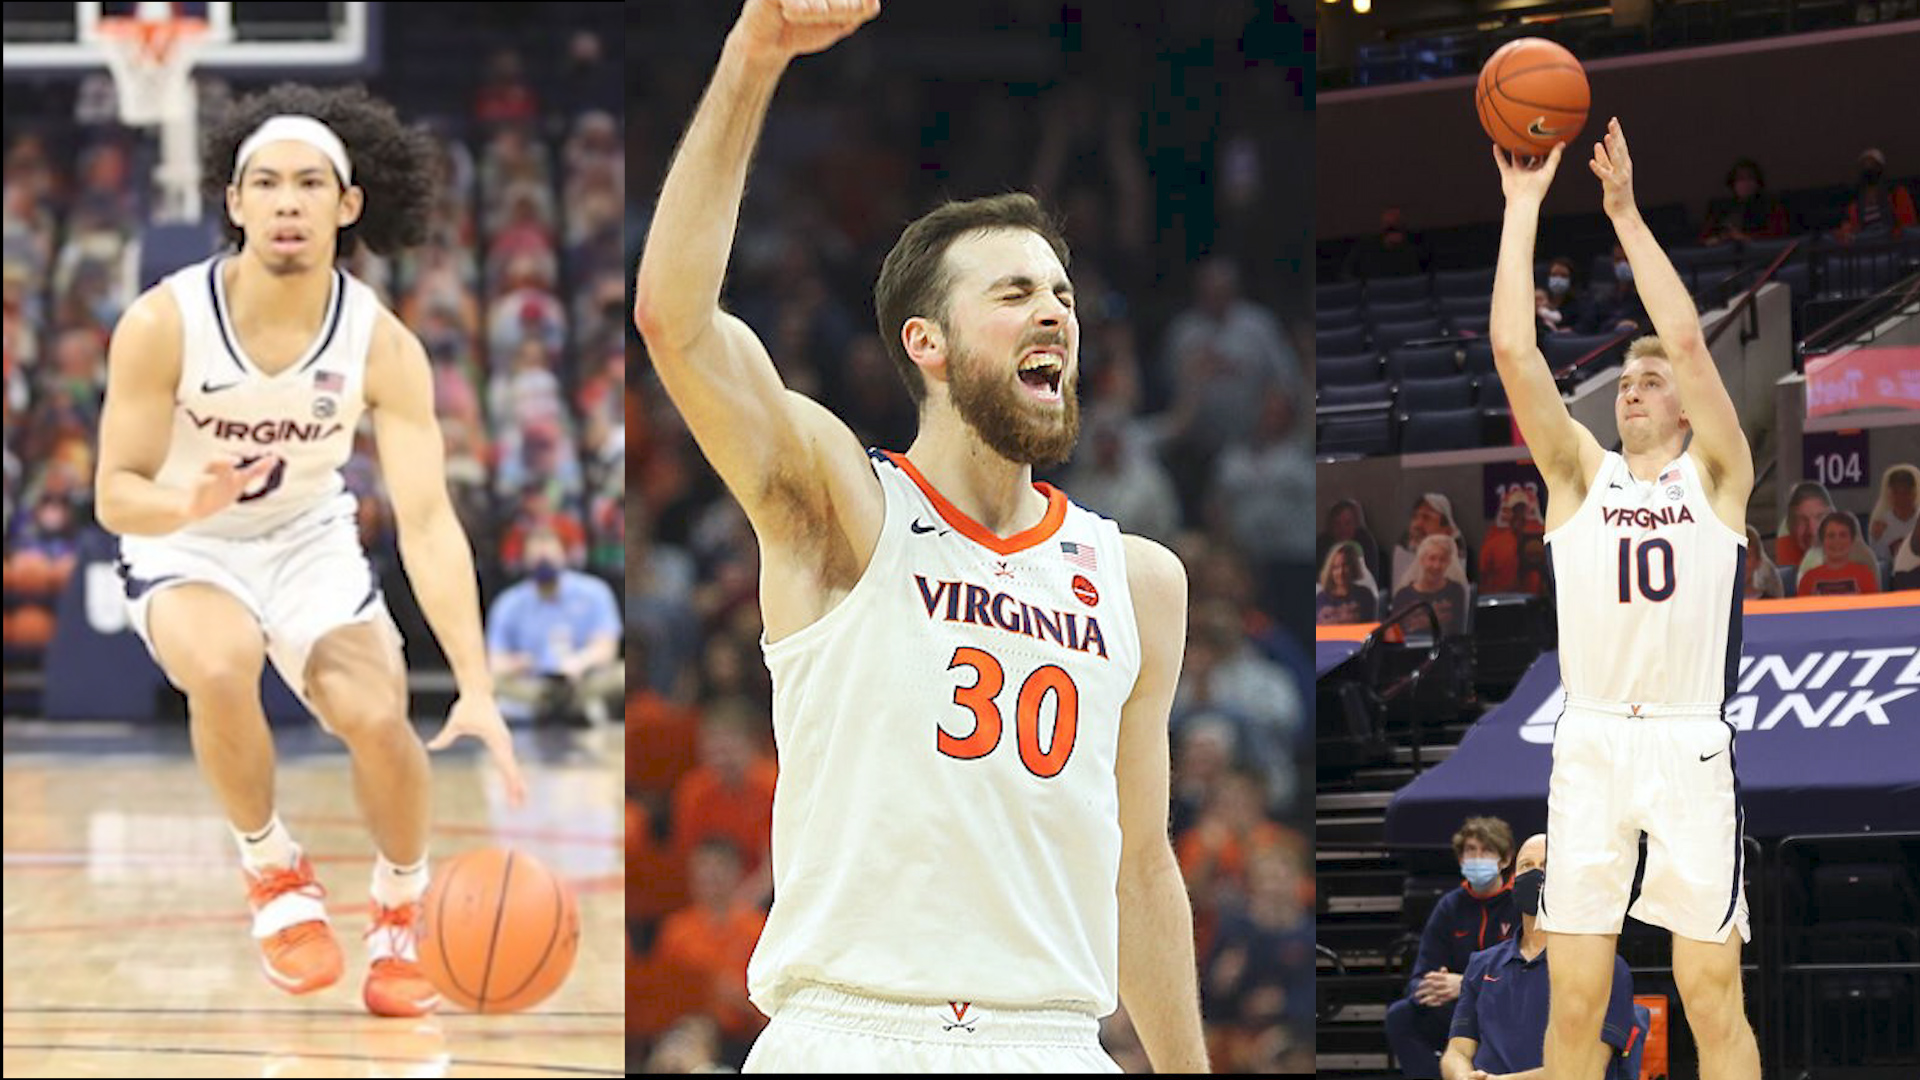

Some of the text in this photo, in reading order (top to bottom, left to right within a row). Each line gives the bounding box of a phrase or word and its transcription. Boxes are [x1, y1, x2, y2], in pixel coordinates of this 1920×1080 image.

[1815, 452, 1862, 485] 104
[1619, 537, 1676, 604] 10
[913, 574, 1110, 661] VIRGINIA
[1737, 646, 1920, 693] NIT
[937, 646, 1079, 779] 30
